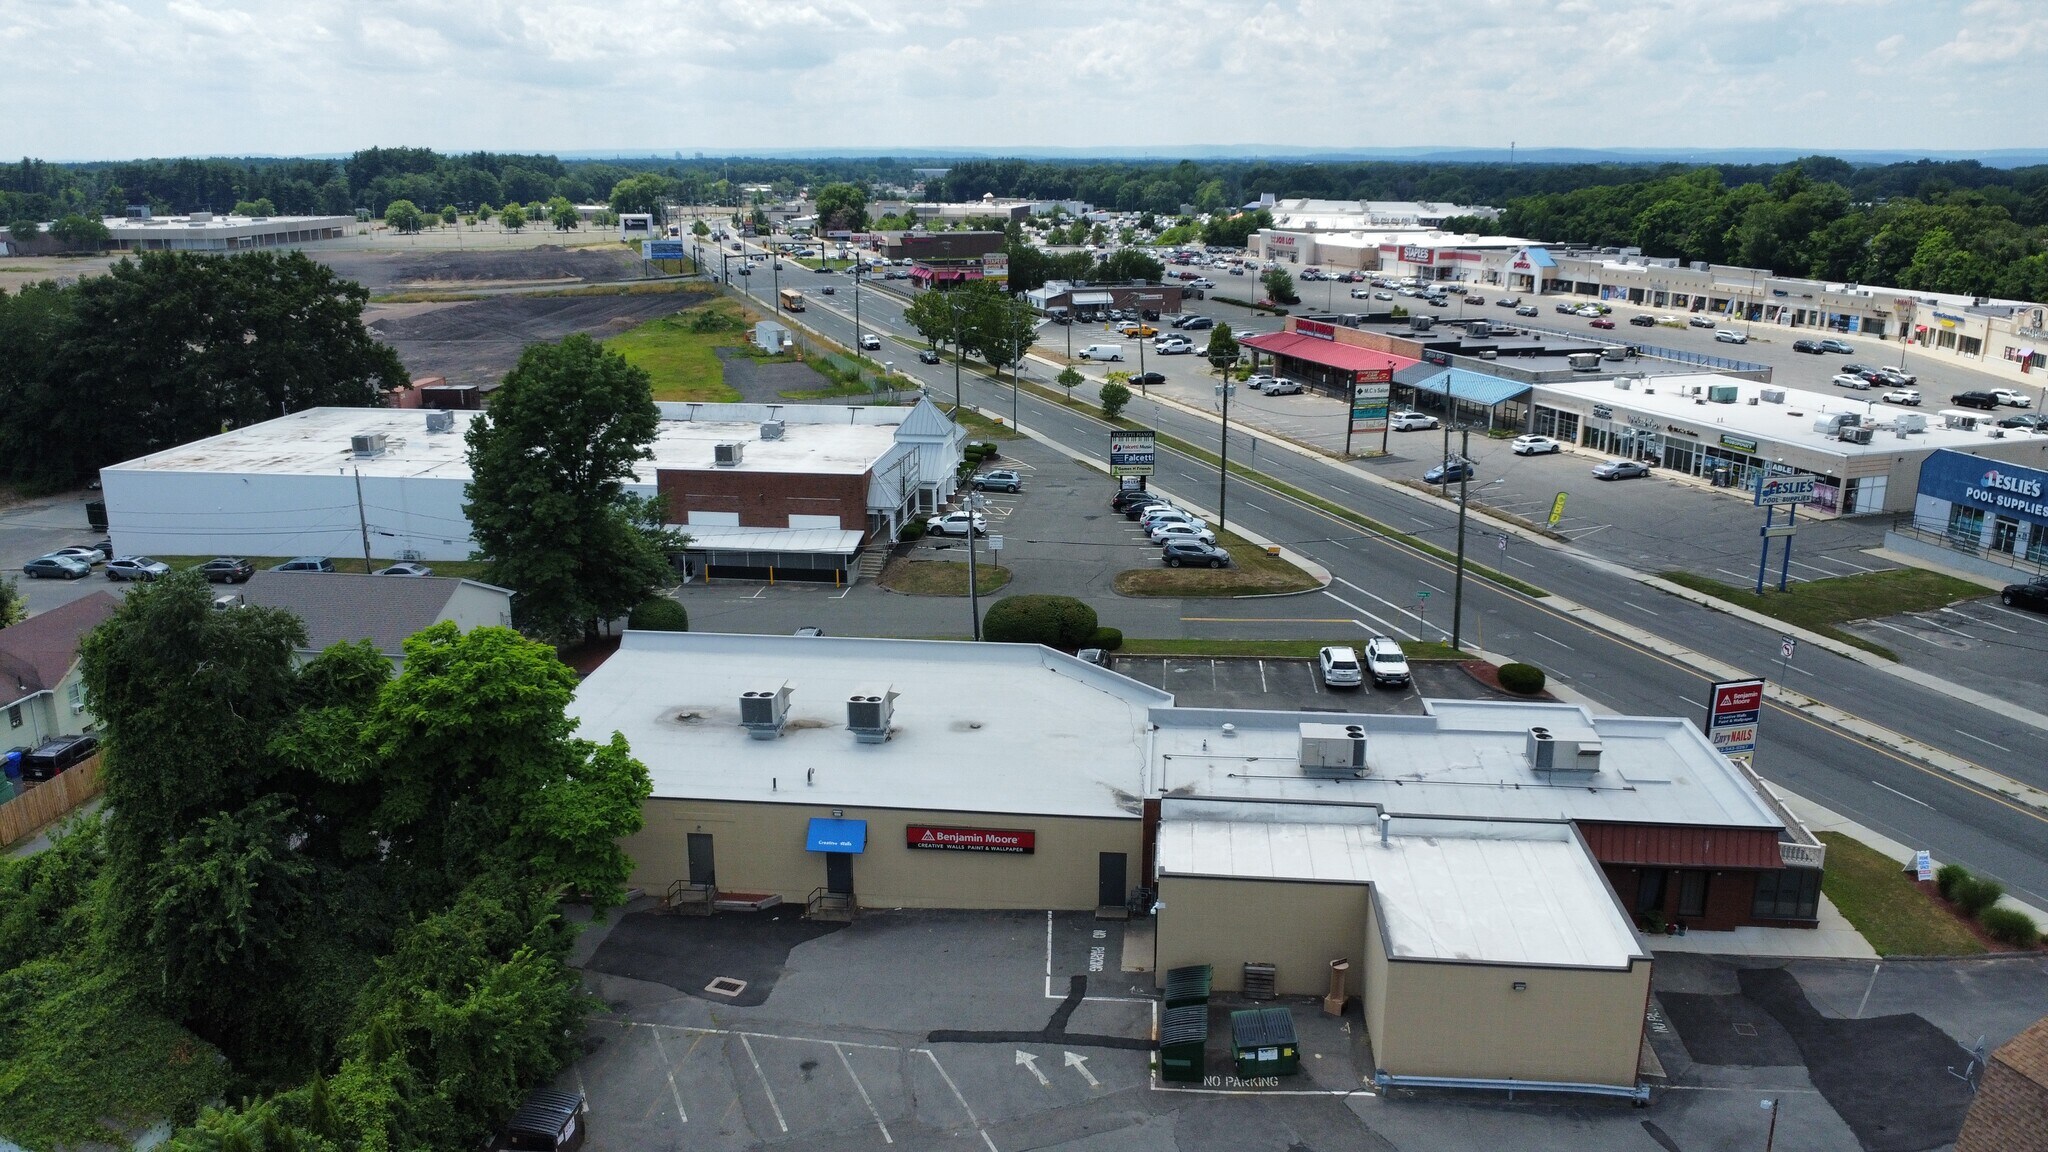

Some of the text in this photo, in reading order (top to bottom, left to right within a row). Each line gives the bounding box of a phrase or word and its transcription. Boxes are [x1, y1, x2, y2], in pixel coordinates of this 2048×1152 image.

[1286, 237, 1295, 245] LOT
[1404, 247, 1429, 260] STAPLES
[1513, 261, 1531, 270] petco
[1124, 454, 1154, 462] Falcetti
[1772, 464, 1793, 474] ABLE
[1768, 480, 1814, 496] LESLIE'S
[1987, 472, 2042, 497] LESLIE'S
[1781, 495, 1811, 503] SUPPLIES
[1966, 487, 2048, 517] POOL SUPPLIES
[1733, 691, 1759, 700] Benjamin
[1713, 729, 1753, 745] Envy NAILS
[936, 832, 1018, 844] Benjamin Moore
[1089, 946, 1105, 972] PARKING
[1203, 1075, 1279, 1087] NO PARKING
